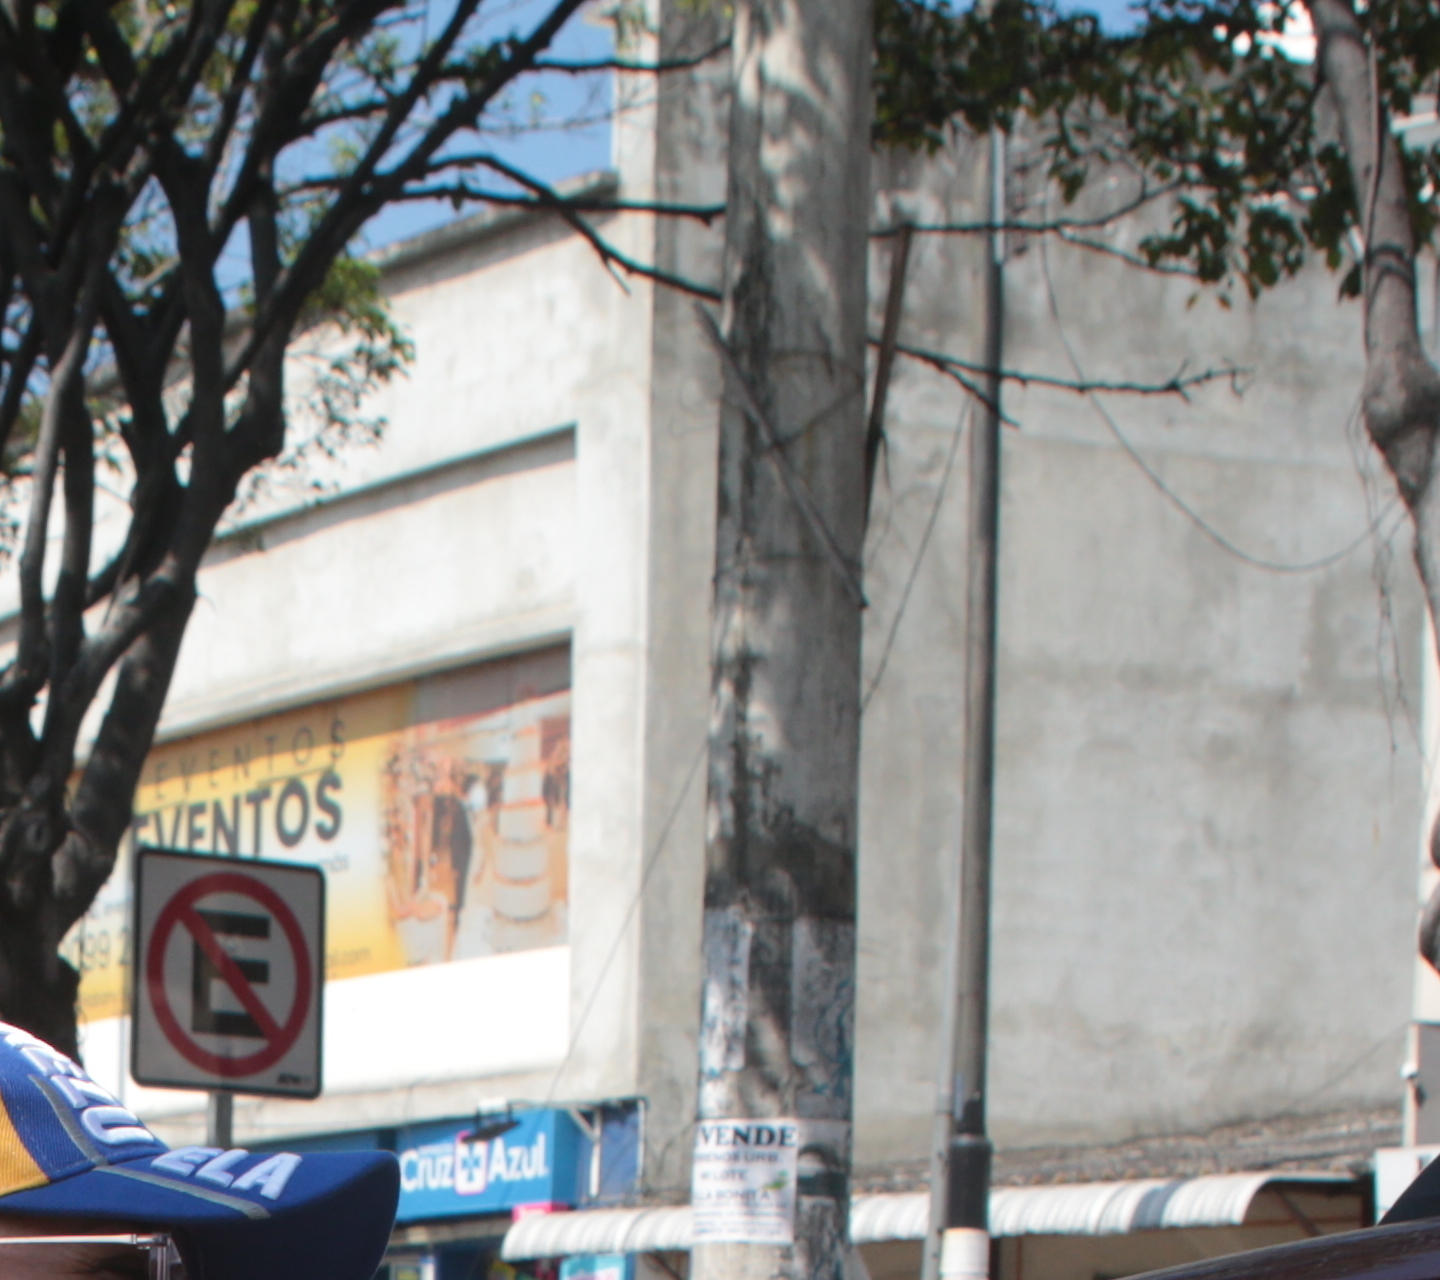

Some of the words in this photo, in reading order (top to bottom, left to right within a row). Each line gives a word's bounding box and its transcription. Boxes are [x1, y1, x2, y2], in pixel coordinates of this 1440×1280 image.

[154, 716, 346, 800] EVENTOS
[133, 771, 343, 858] EVENTOS
[399, 1148, 455, 1191] Cruz
